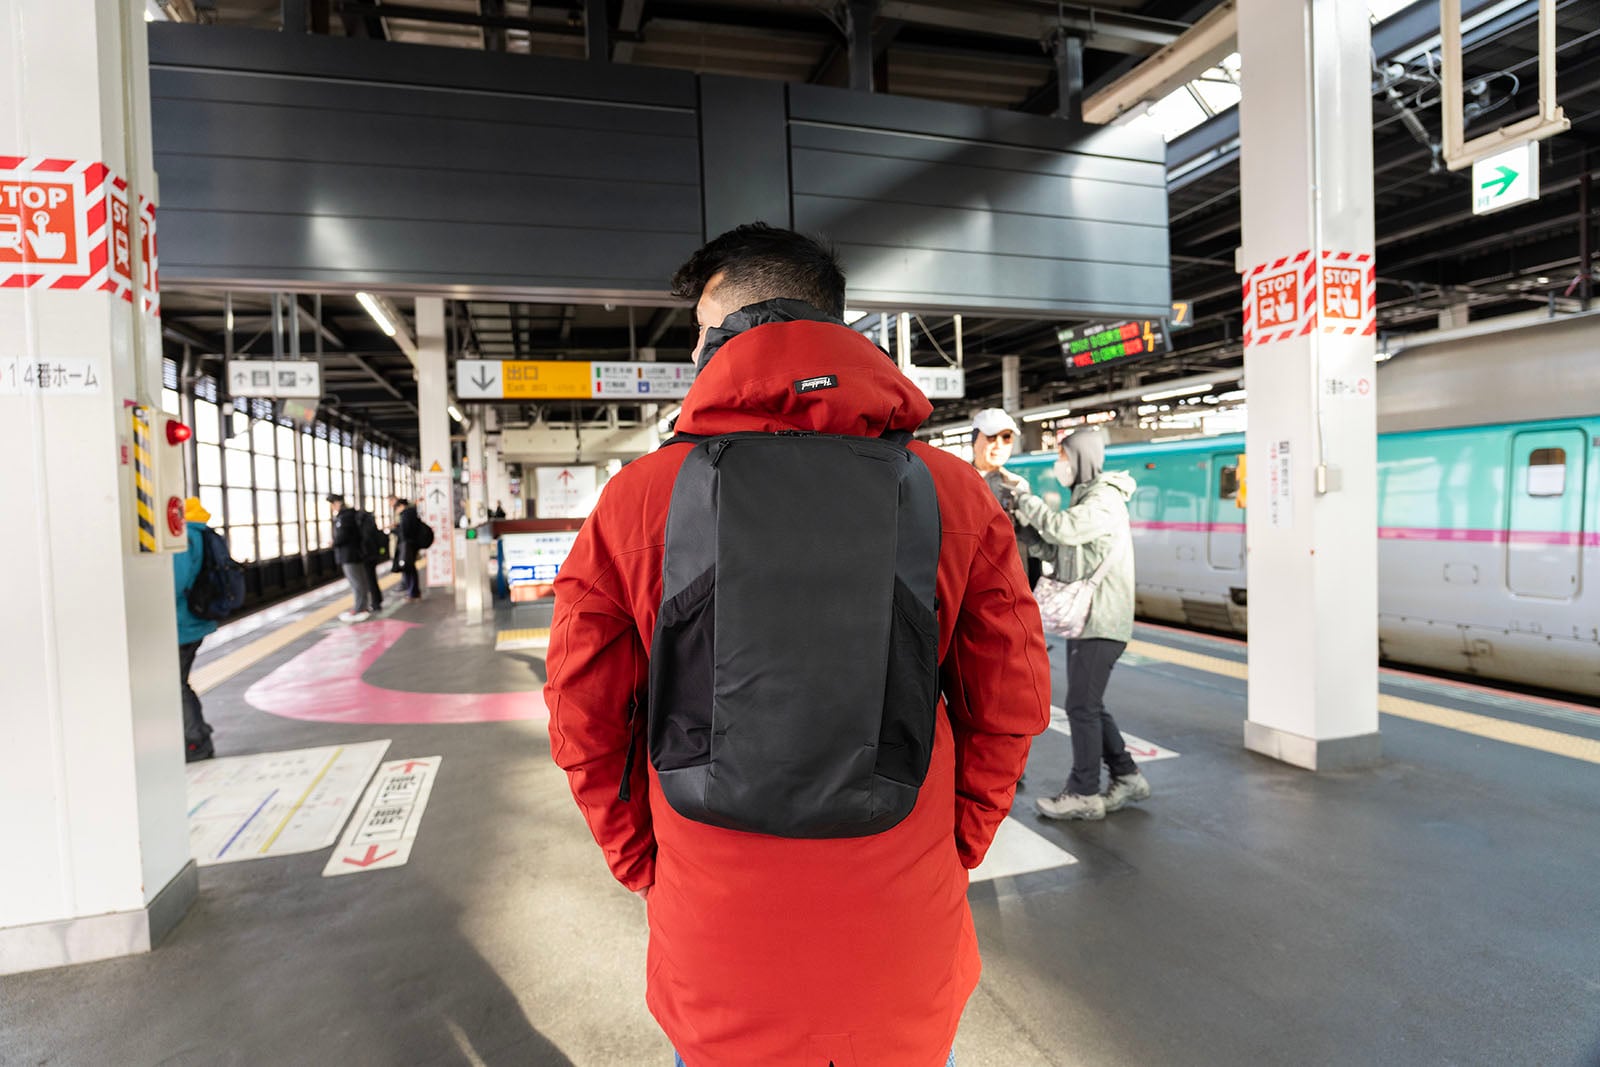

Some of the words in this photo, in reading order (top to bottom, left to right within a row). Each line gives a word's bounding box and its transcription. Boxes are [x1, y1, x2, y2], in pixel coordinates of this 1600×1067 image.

[0, 185, 67, 209] TOP
[1258, 273, 1296, 297] STOP
[1324, 269, 1361, 286] STOP
[506, 364, 539, 381] 出口
